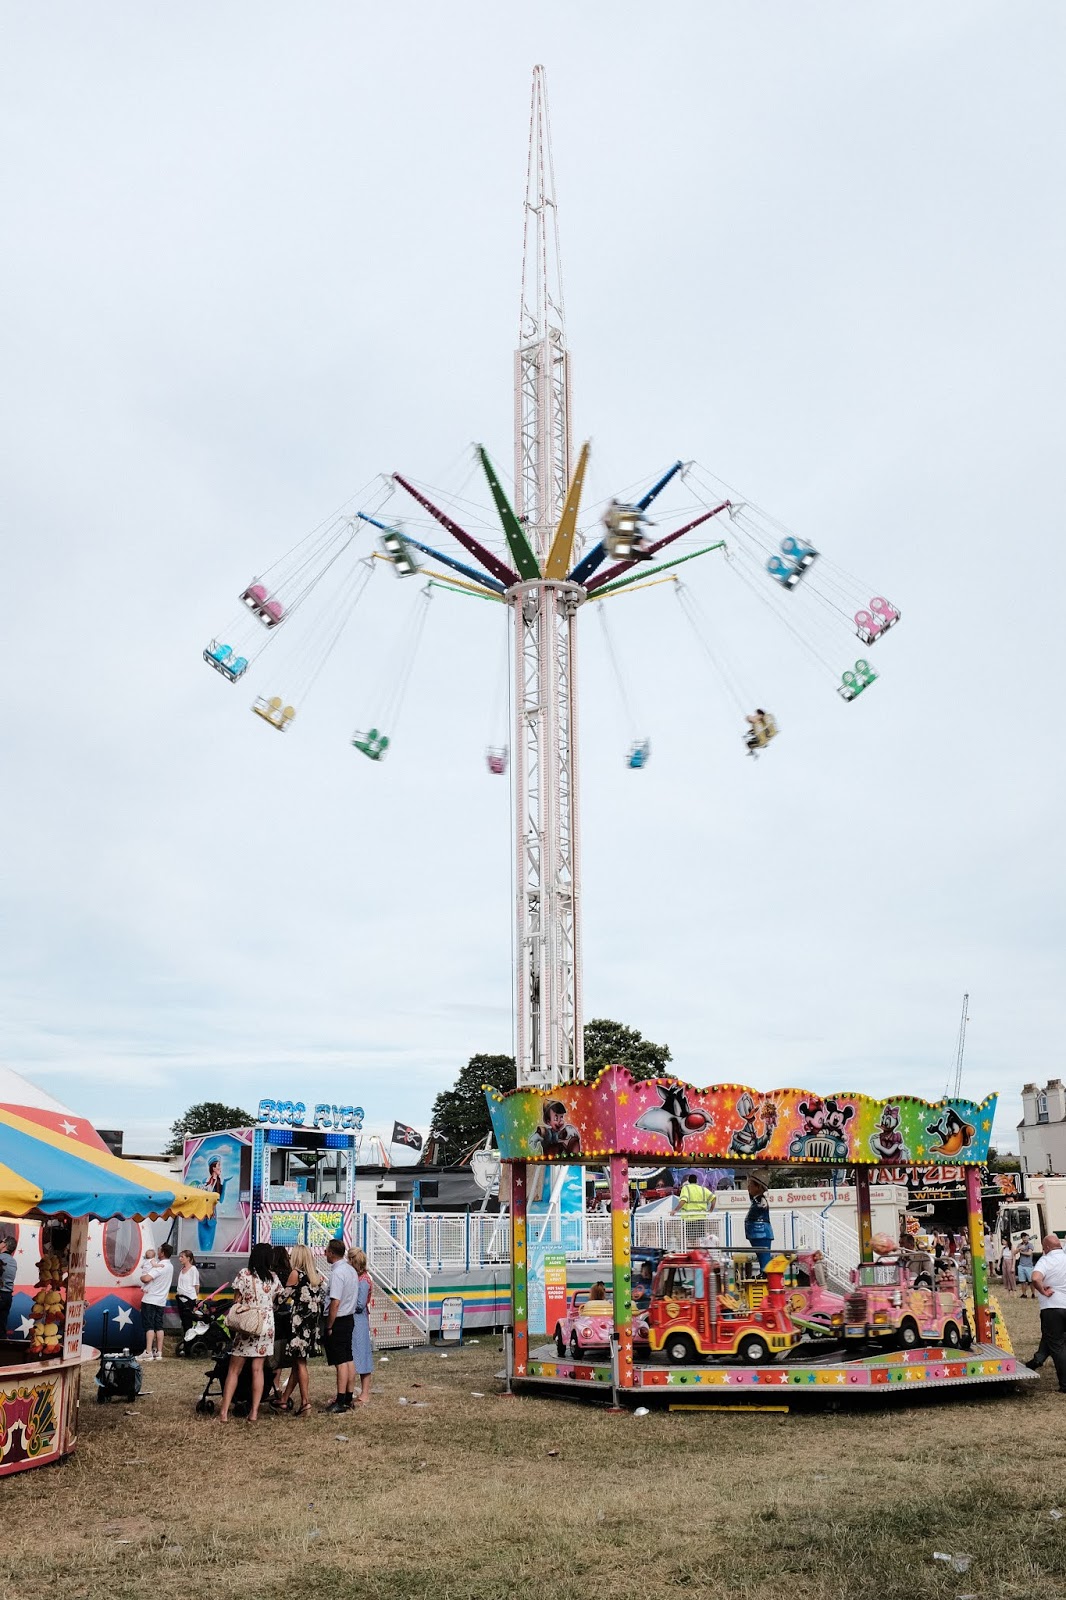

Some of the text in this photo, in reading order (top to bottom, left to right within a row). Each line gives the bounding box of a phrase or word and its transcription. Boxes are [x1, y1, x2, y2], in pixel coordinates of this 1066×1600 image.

[258, 1099, 365, 1130] EURO FLYER
[786, 1192, 817, 1203] Sweet
[819, 1190, 851, 1203] Thng
[913, 1191, 952, 1200] WITH
[66, 1321, 81, 1337] EVERY
[66, 1339, 80, 1353] TIME
